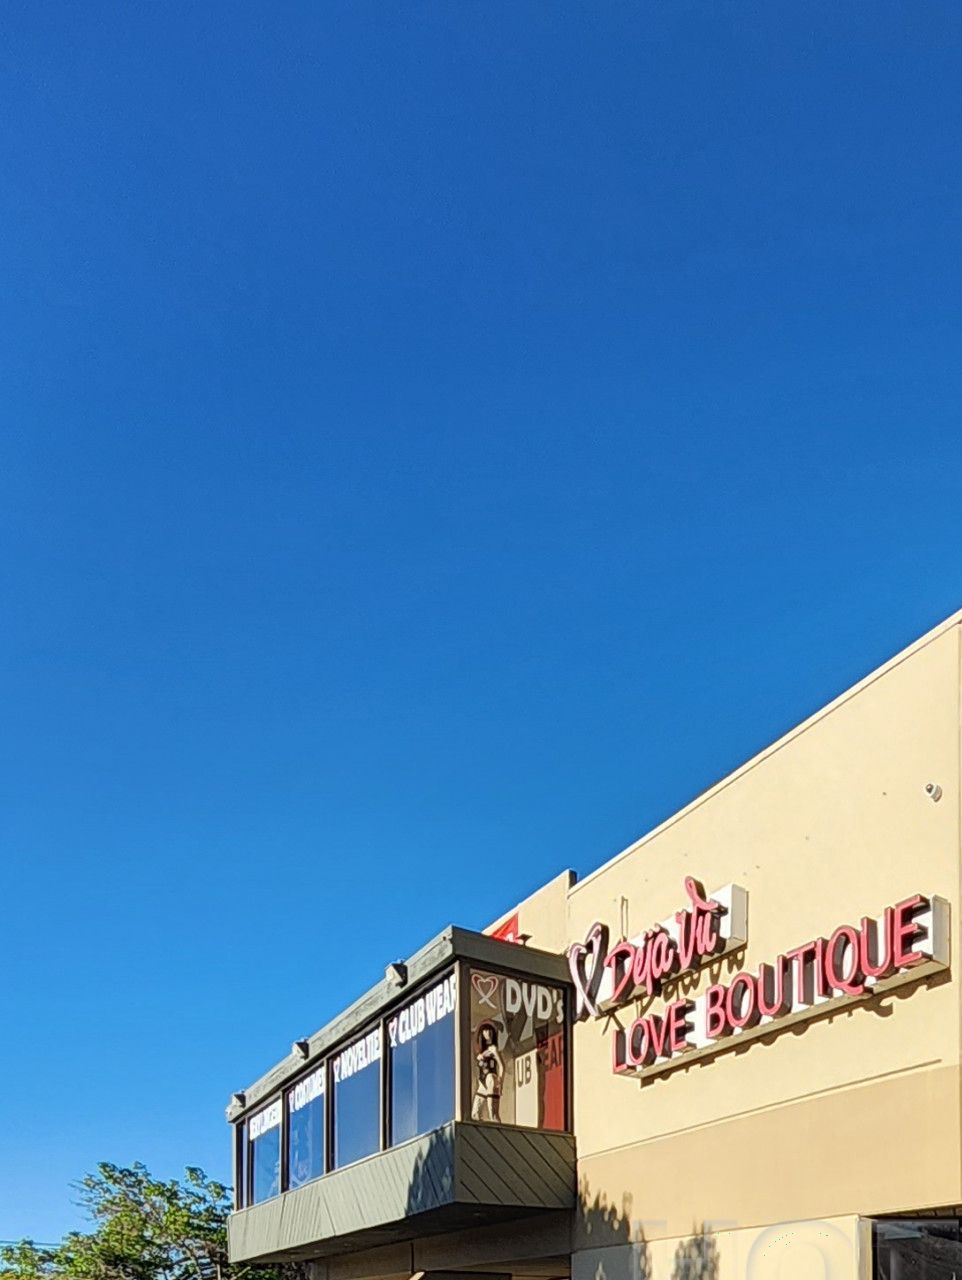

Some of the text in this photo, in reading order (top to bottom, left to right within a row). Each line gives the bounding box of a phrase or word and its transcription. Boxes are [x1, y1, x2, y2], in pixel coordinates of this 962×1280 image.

[612, 894, 929, 1075] LOVE BOUTIQUE
[399, 998, 425, 1044] CLUB
[341, 1028, 381, 1081] NOVELTIE
